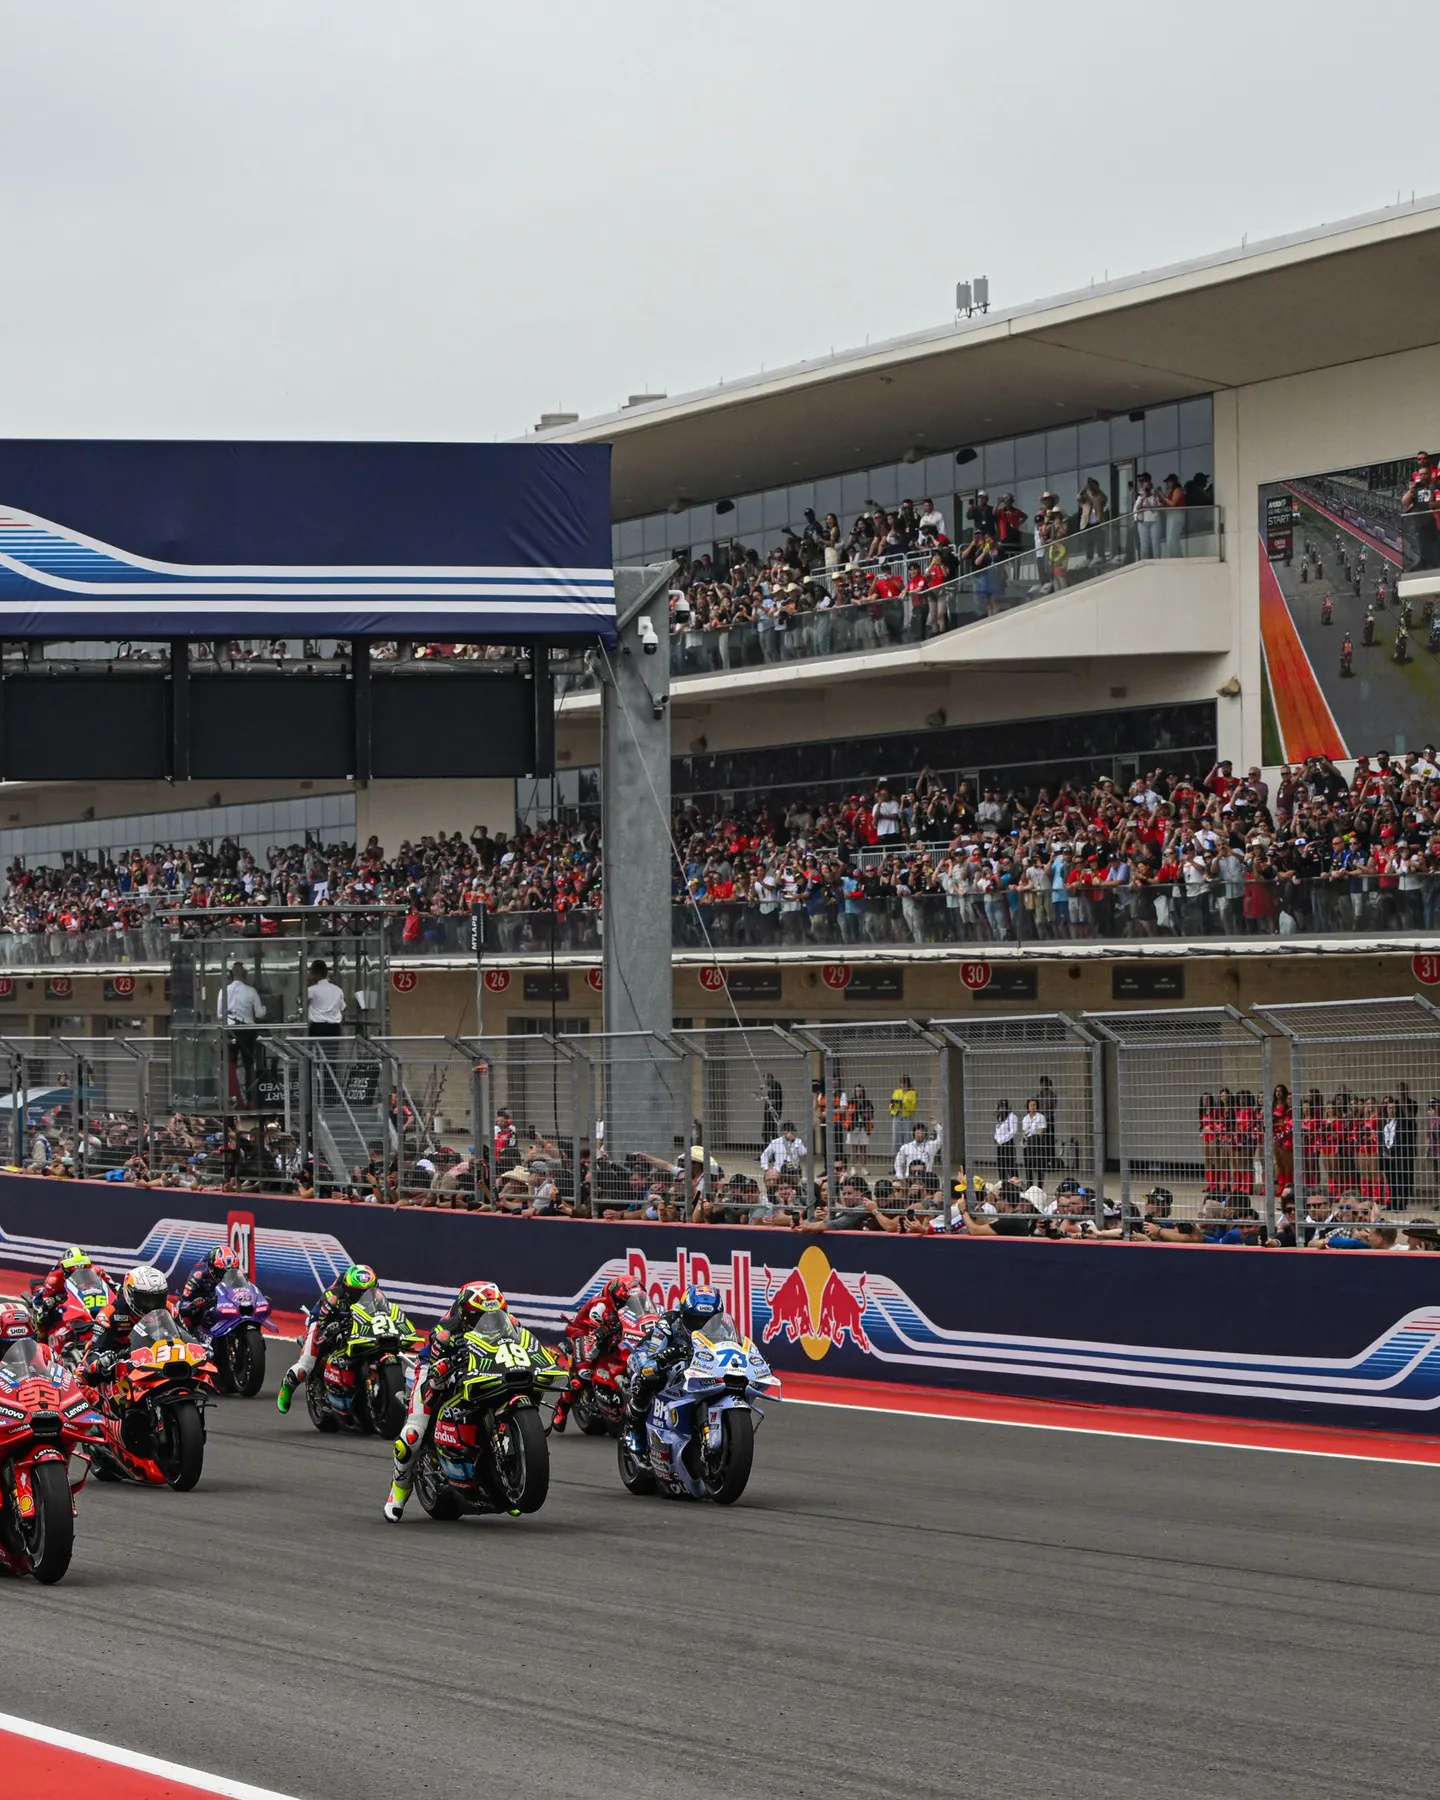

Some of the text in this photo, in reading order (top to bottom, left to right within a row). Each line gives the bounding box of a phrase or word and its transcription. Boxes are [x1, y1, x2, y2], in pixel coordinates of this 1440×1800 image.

[967, 966, 985, 983] 30
[1421, 956, 1438, 978] 31
[56, 977, 68, 992] 22
[118, 976, 133, 992] 23
[398, 973, 412, 988] 25
[491, 972, 505, 988] 26
[595, 971, 603, 988] 2
[705, 970, 721, 986] 28
[829, 969, 845, 985] 29
[83, 1294, 107, 1310] 36
[9, 1327, 27, 1335] SHOEI
[370, 1315, 399, 1336] 21
[156, 1345, 187, 1362] 37
[495, 1343, 532, 1368] 49
[716, 1348, 748, 1369] 73
[17, 1384, 61, 1412] 93
[64, 1401, 90, 1419] Lenovo
